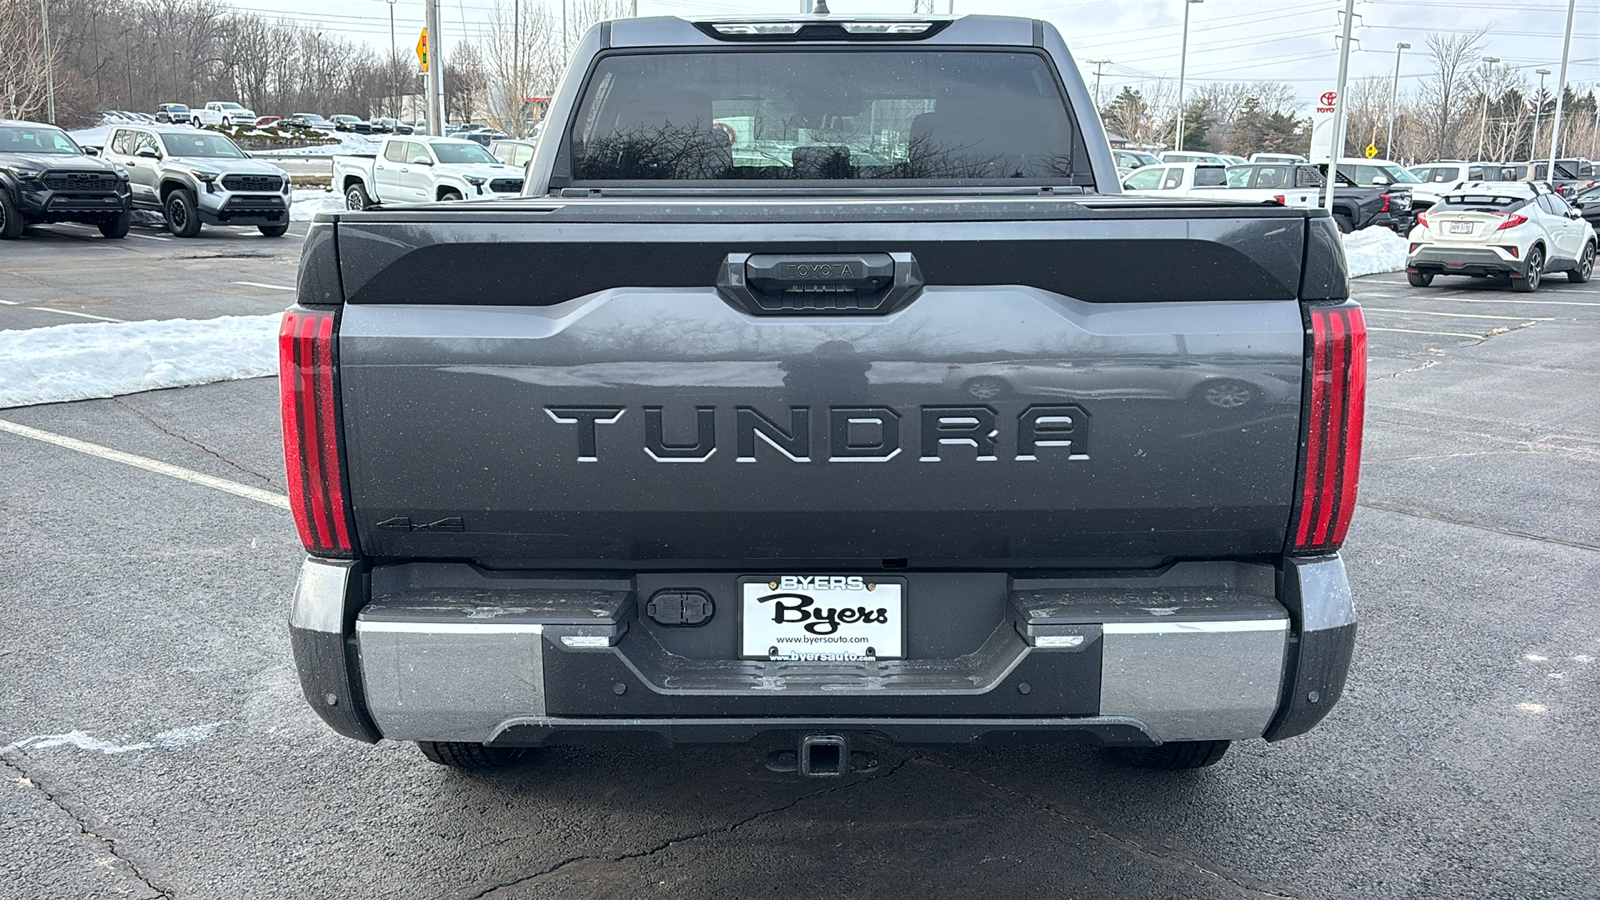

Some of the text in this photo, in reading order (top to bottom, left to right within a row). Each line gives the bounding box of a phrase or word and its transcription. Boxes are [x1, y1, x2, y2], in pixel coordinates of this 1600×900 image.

[786, 264, 853, 278] TOYOTA
[543, 404, 1092, 463] TUNDRA
[780, 575, 864, 590] BYERS
[756, 593, 888, 635] Byers
[776, 635, 869, 645] www.byersauto.com
[769, 651, 876, 661] www.byersauto.com
